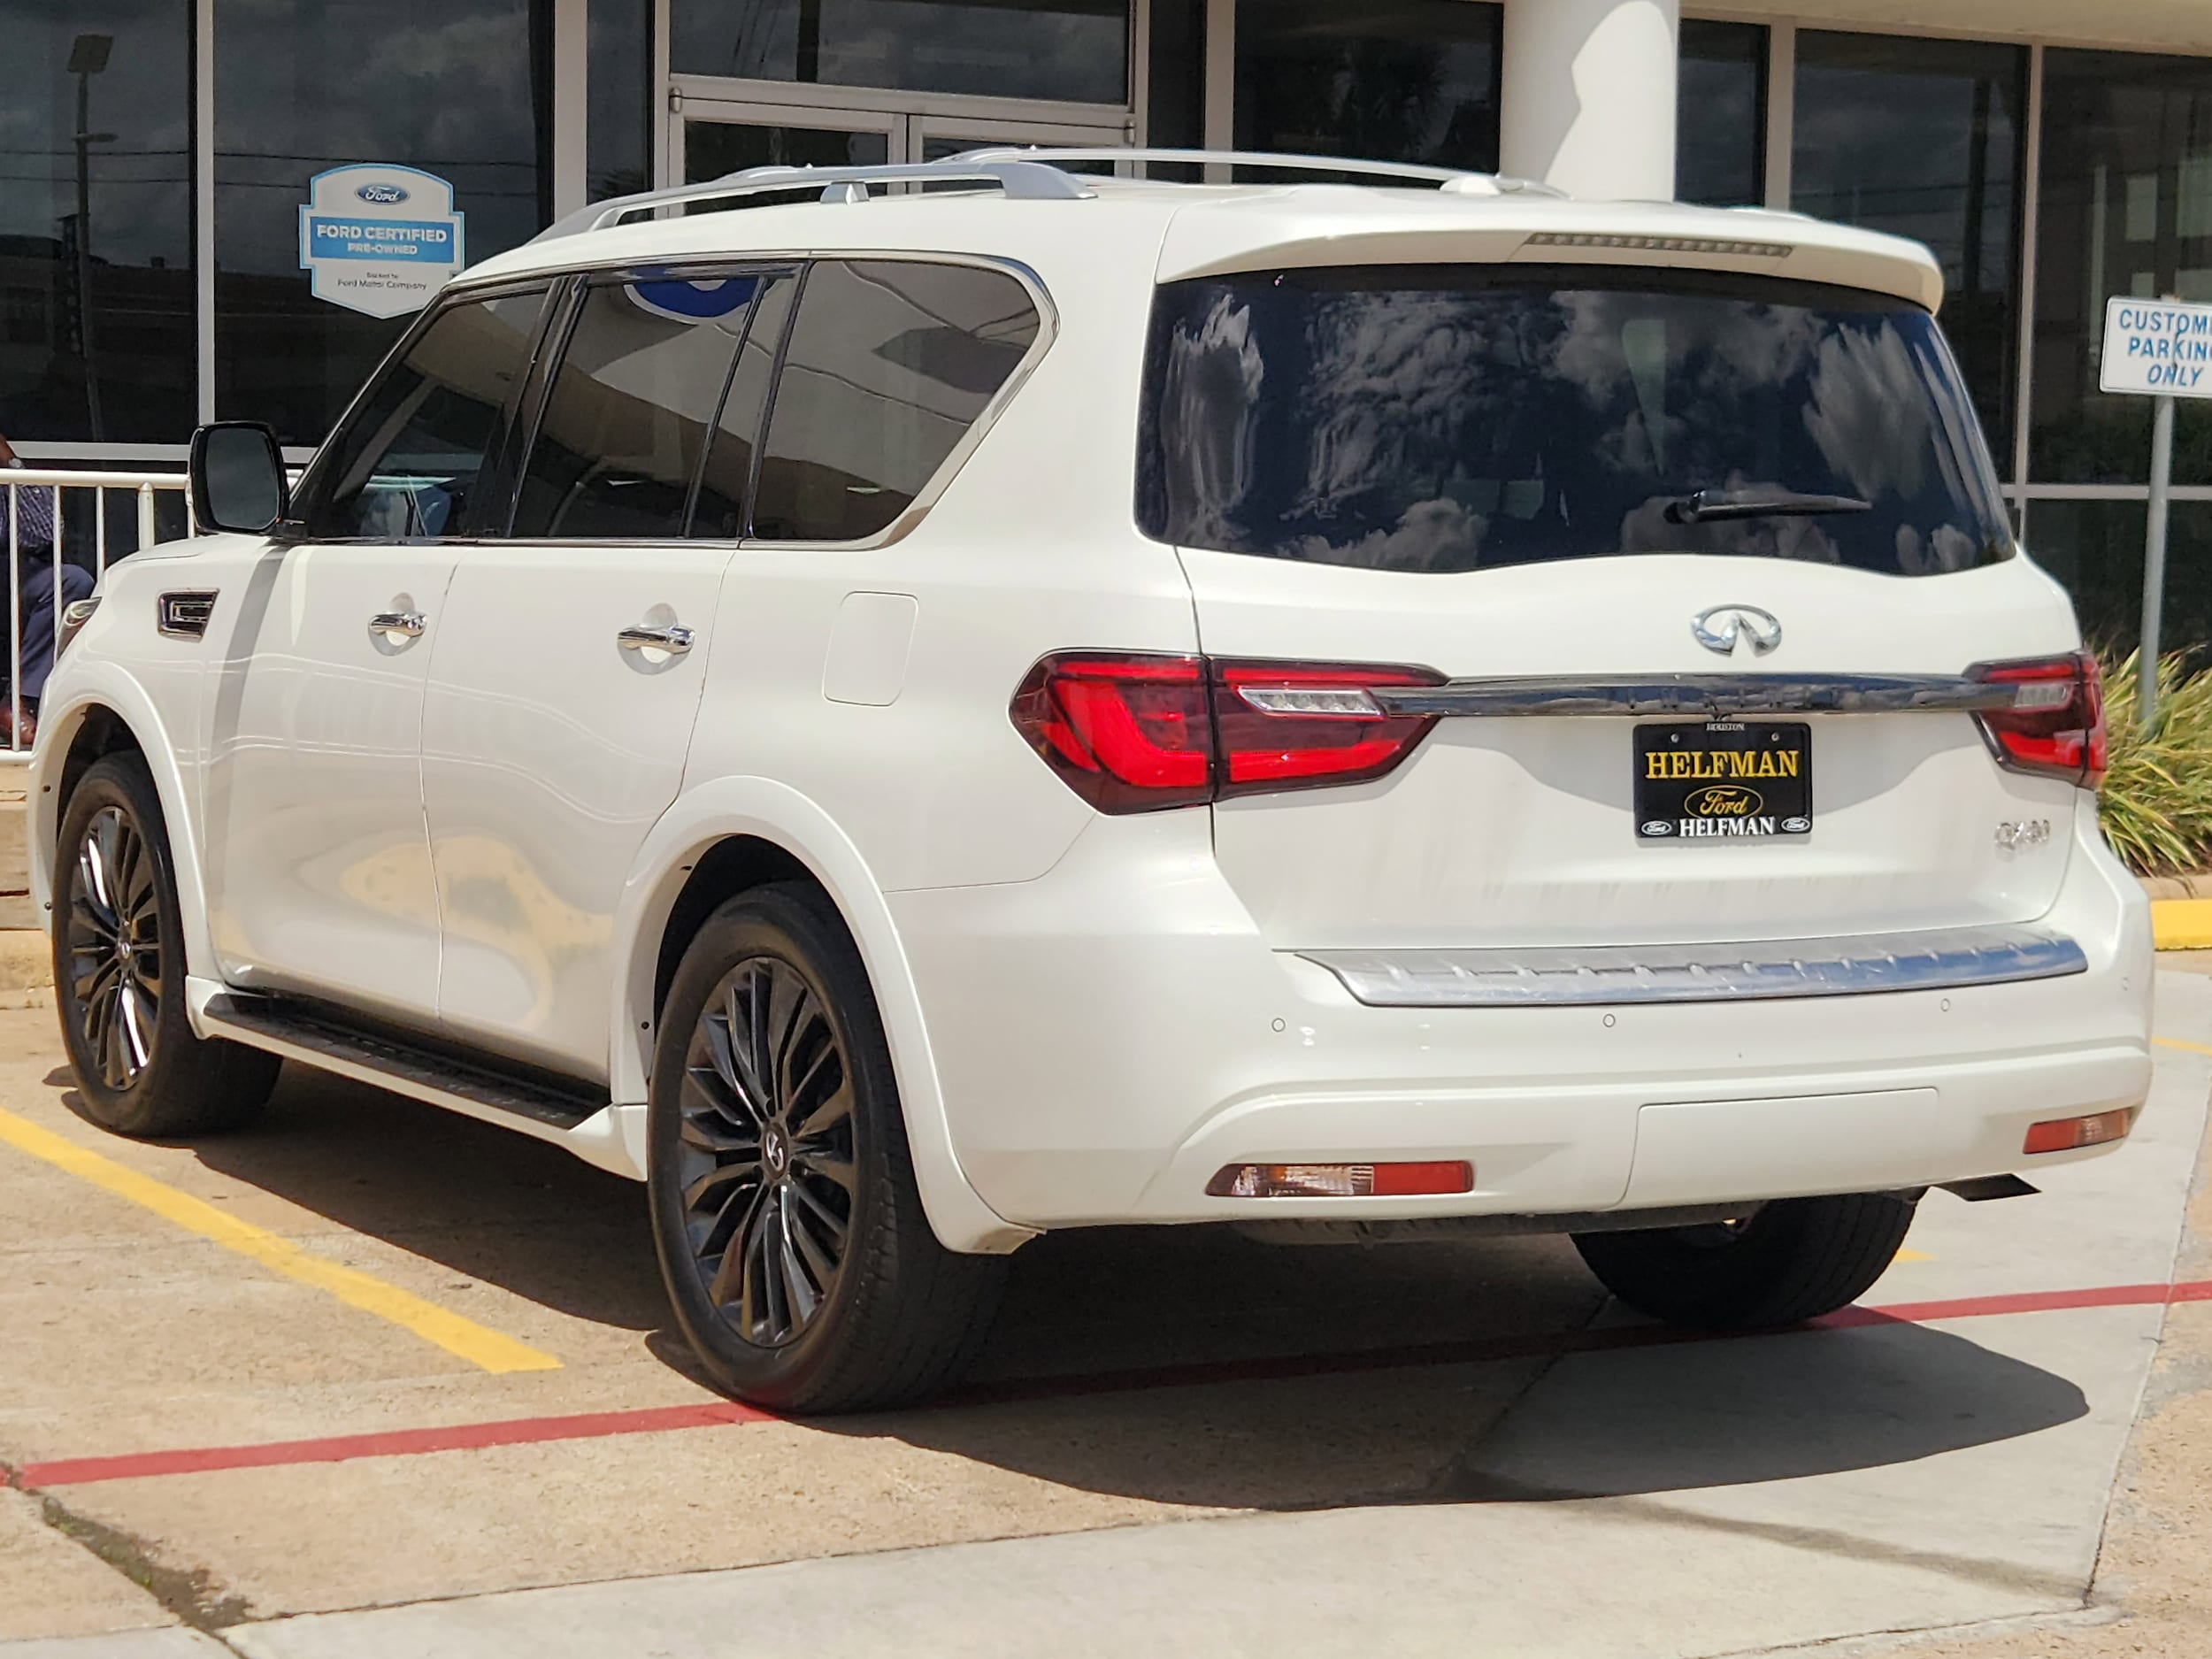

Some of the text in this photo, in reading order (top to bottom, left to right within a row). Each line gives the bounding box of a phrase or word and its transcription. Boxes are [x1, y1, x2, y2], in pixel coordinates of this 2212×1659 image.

[365, 186, 401, 202] Ford
[316, 224, 448, 243] FORD CERTIFIED
[347, 242, 419, 256] PRE-OWNED
[359, 279, 384, 288] Motor
[386, 280, 427, 291] Company
[2147, 363, 2204, 388] ONLY
[1645, 749, 1800, 780] HELFMAN
[1699, 789, 1749, 815] Ford
[1678, 816, 1776, 838] HELFMAN
